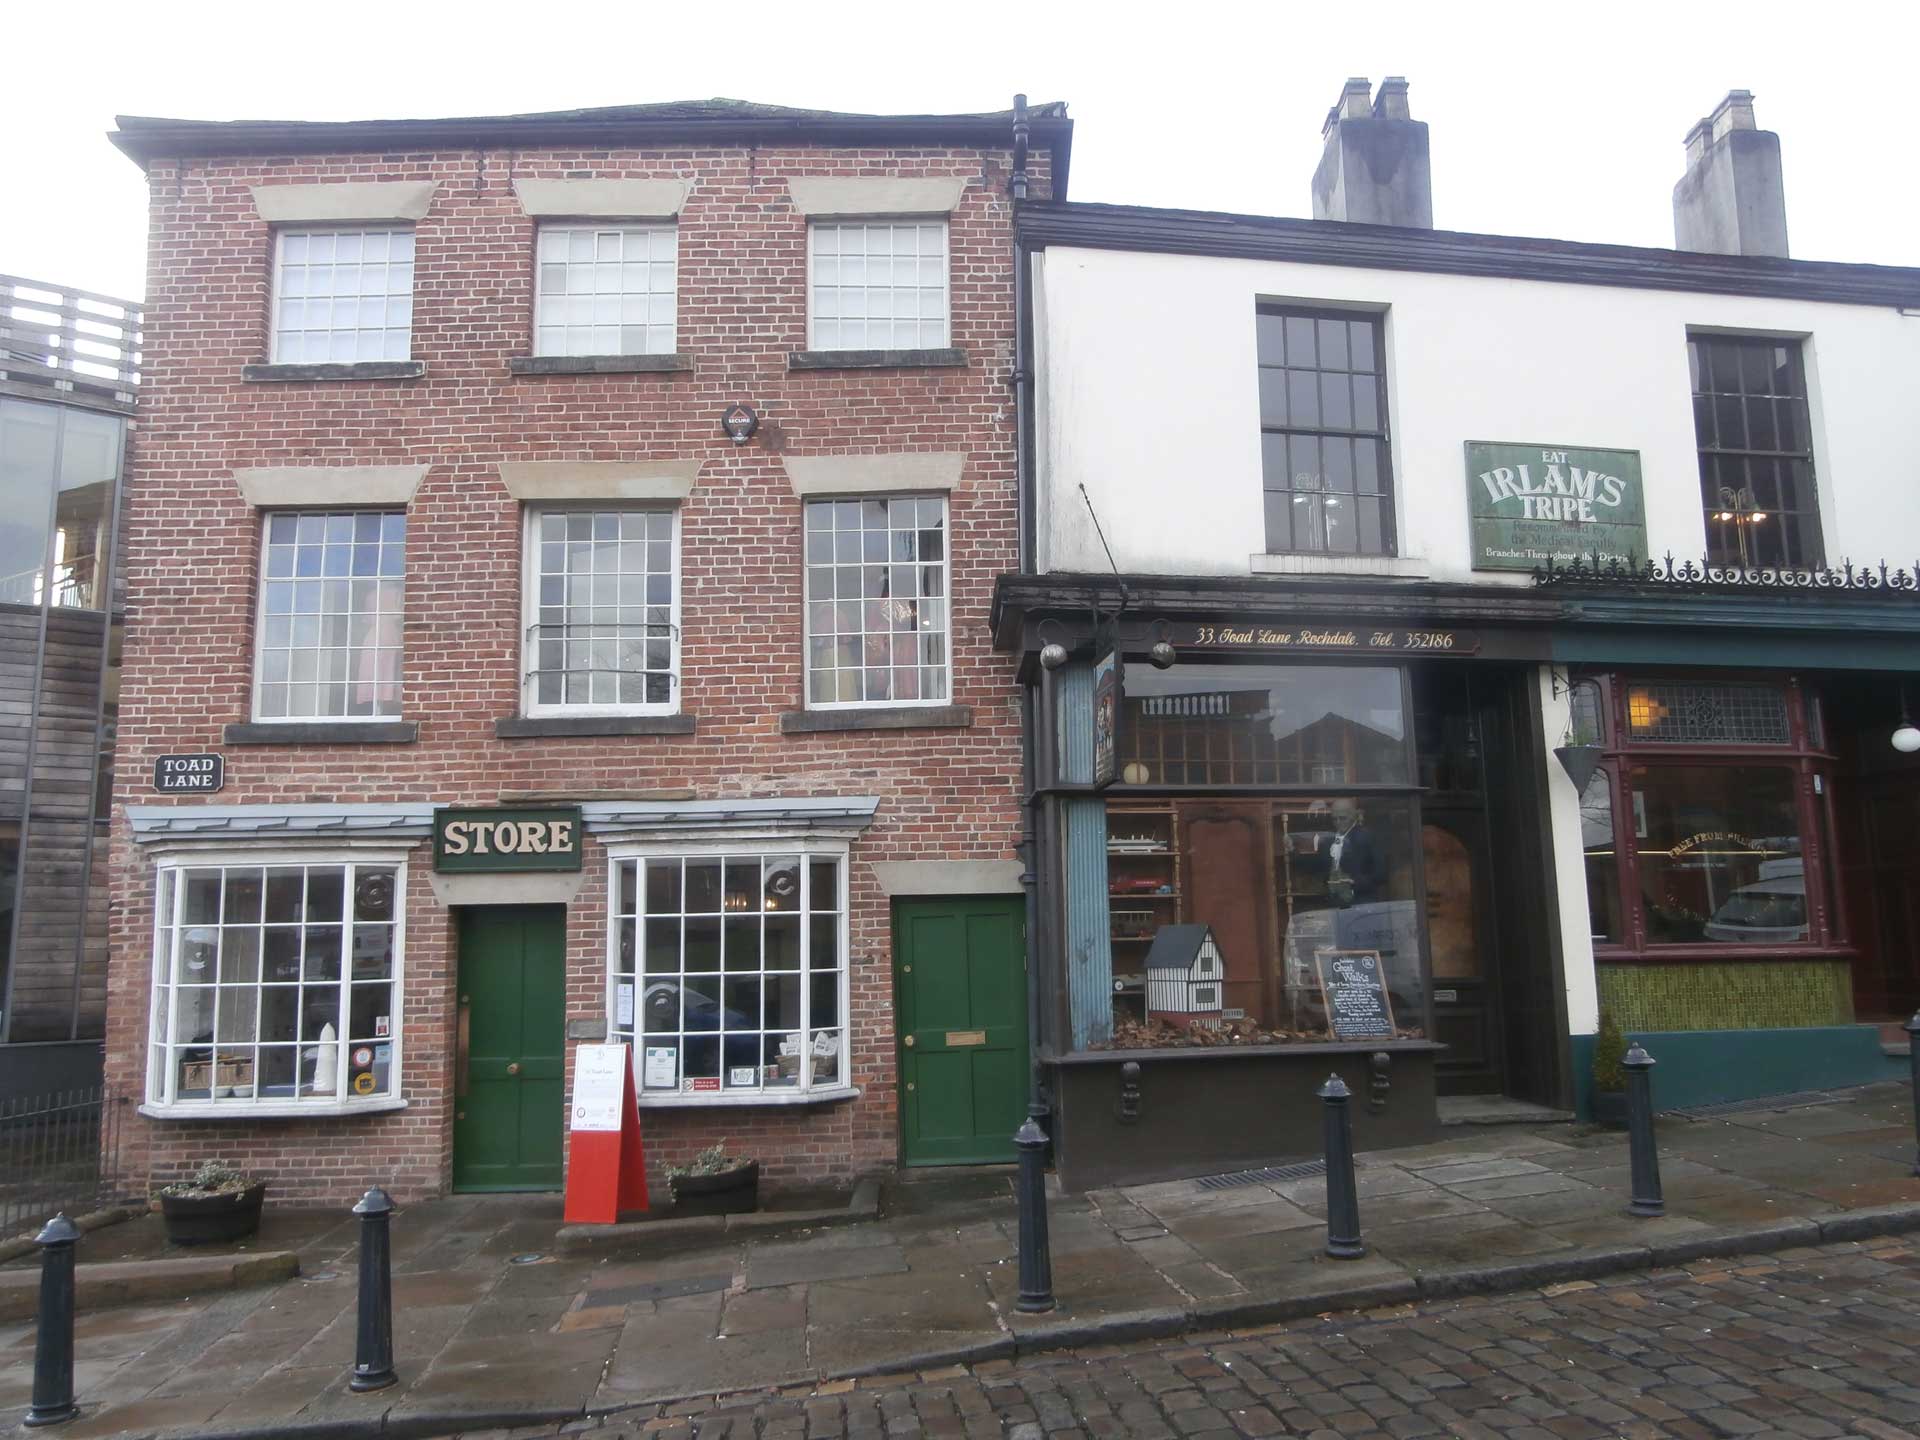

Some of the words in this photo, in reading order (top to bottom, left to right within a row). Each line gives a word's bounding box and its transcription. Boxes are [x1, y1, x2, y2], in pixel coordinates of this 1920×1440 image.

[1542, 450, 1568, 464] EAT
[1479, 464, 1627, 507] IRLAM'S
[1517, 495, 1597, 522] TRIPE
[1486, 546, 1525, 558] Branches
[1217, 628, 1254, 644] Toad
[1369, 632, 1396, 647] Tel.
[1403, 632, 1453, 649] 352186
[164, 759, 214, 772] TOAD
[163, 775, 213, 787] LANE
[444, 821, 573, 854] STORE
